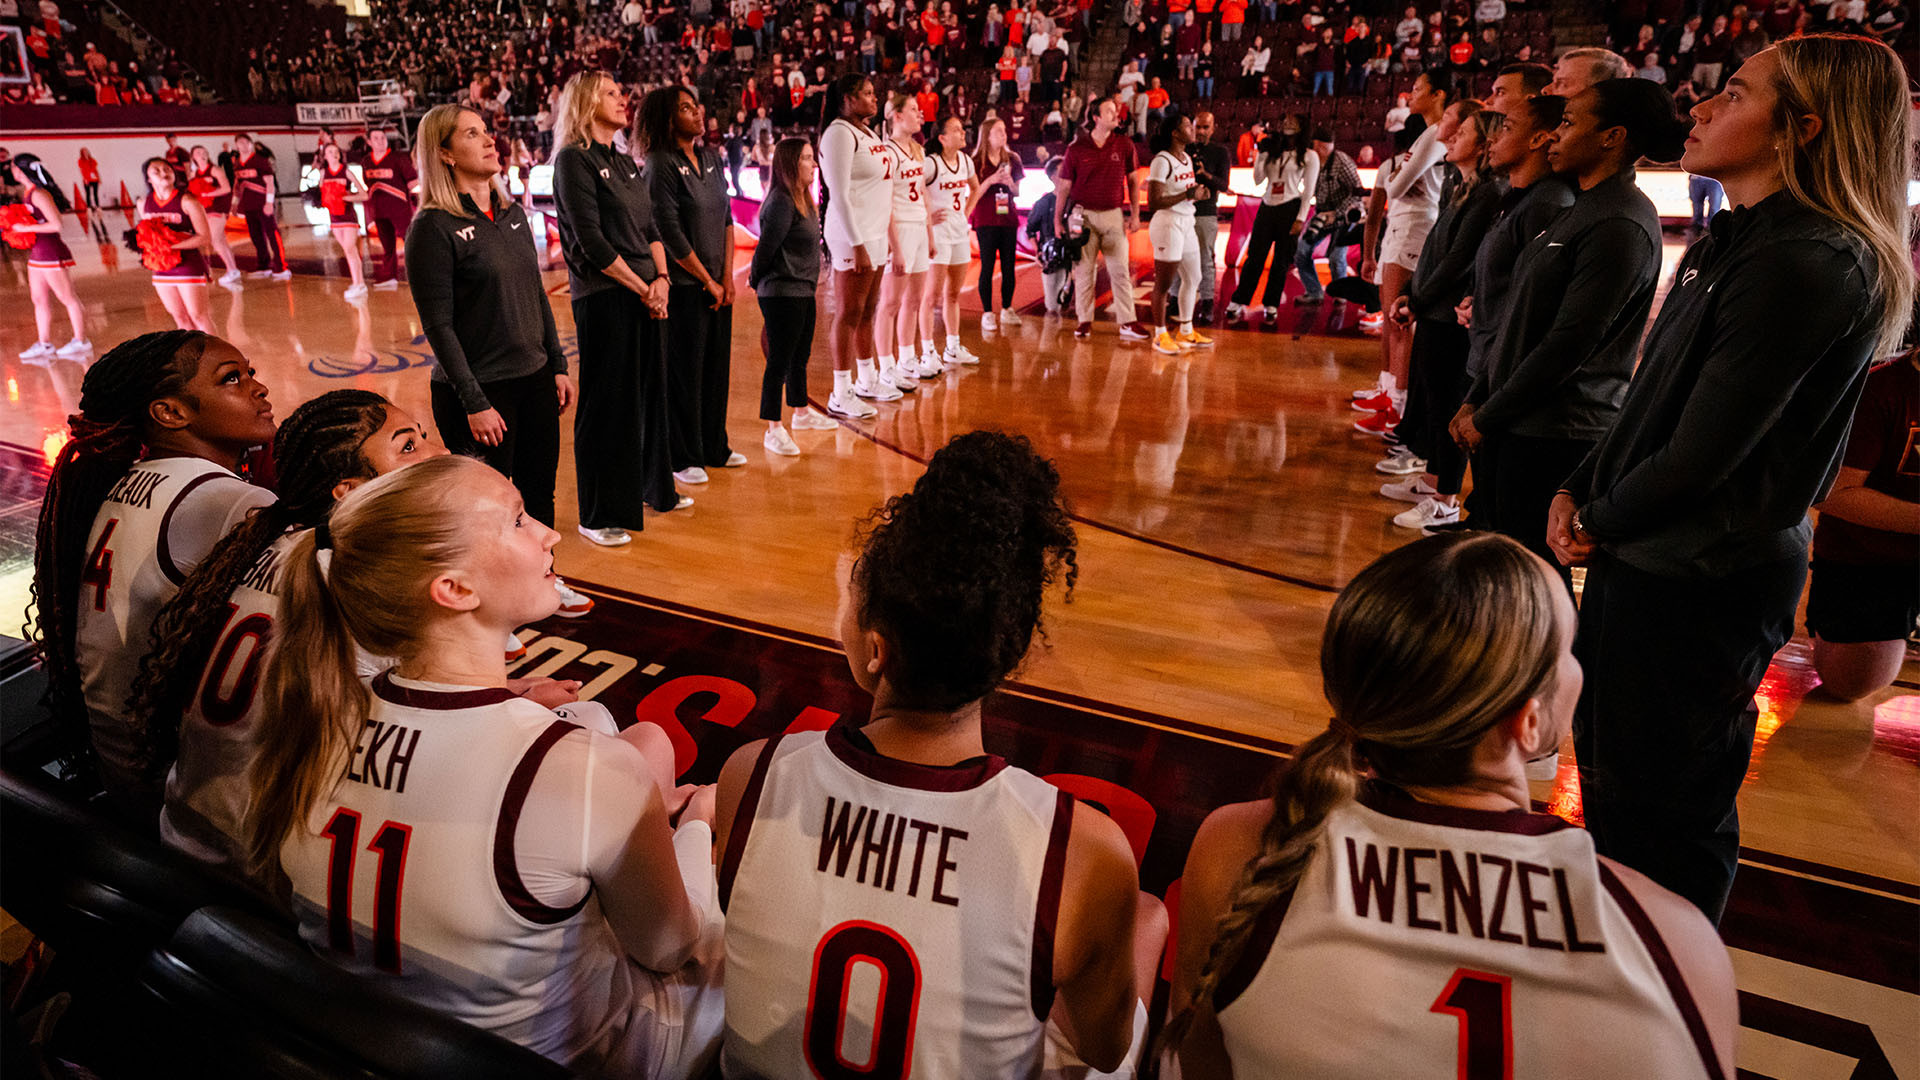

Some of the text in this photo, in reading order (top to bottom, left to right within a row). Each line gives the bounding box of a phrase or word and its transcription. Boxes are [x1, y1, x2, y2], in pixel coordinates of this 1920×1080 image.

[300, 106, 317, 120] THE
[455, 225, 475, 241] VT
[909, 181, 919, 202] 3
[952, 192, 961, 211] 3
[82, 518, 120, 613] 4
[241, 549, 280, 594] BAK
[346, 719, 422, 793] EKH
[320, 806, 413, 976] 11
[817, 796, 969, 907] WHITE
[1345, 836, 1606, 954] WENZEL
[803, 919, 923, 1080] 0
[1429, 967, 1514, 1080] 1
